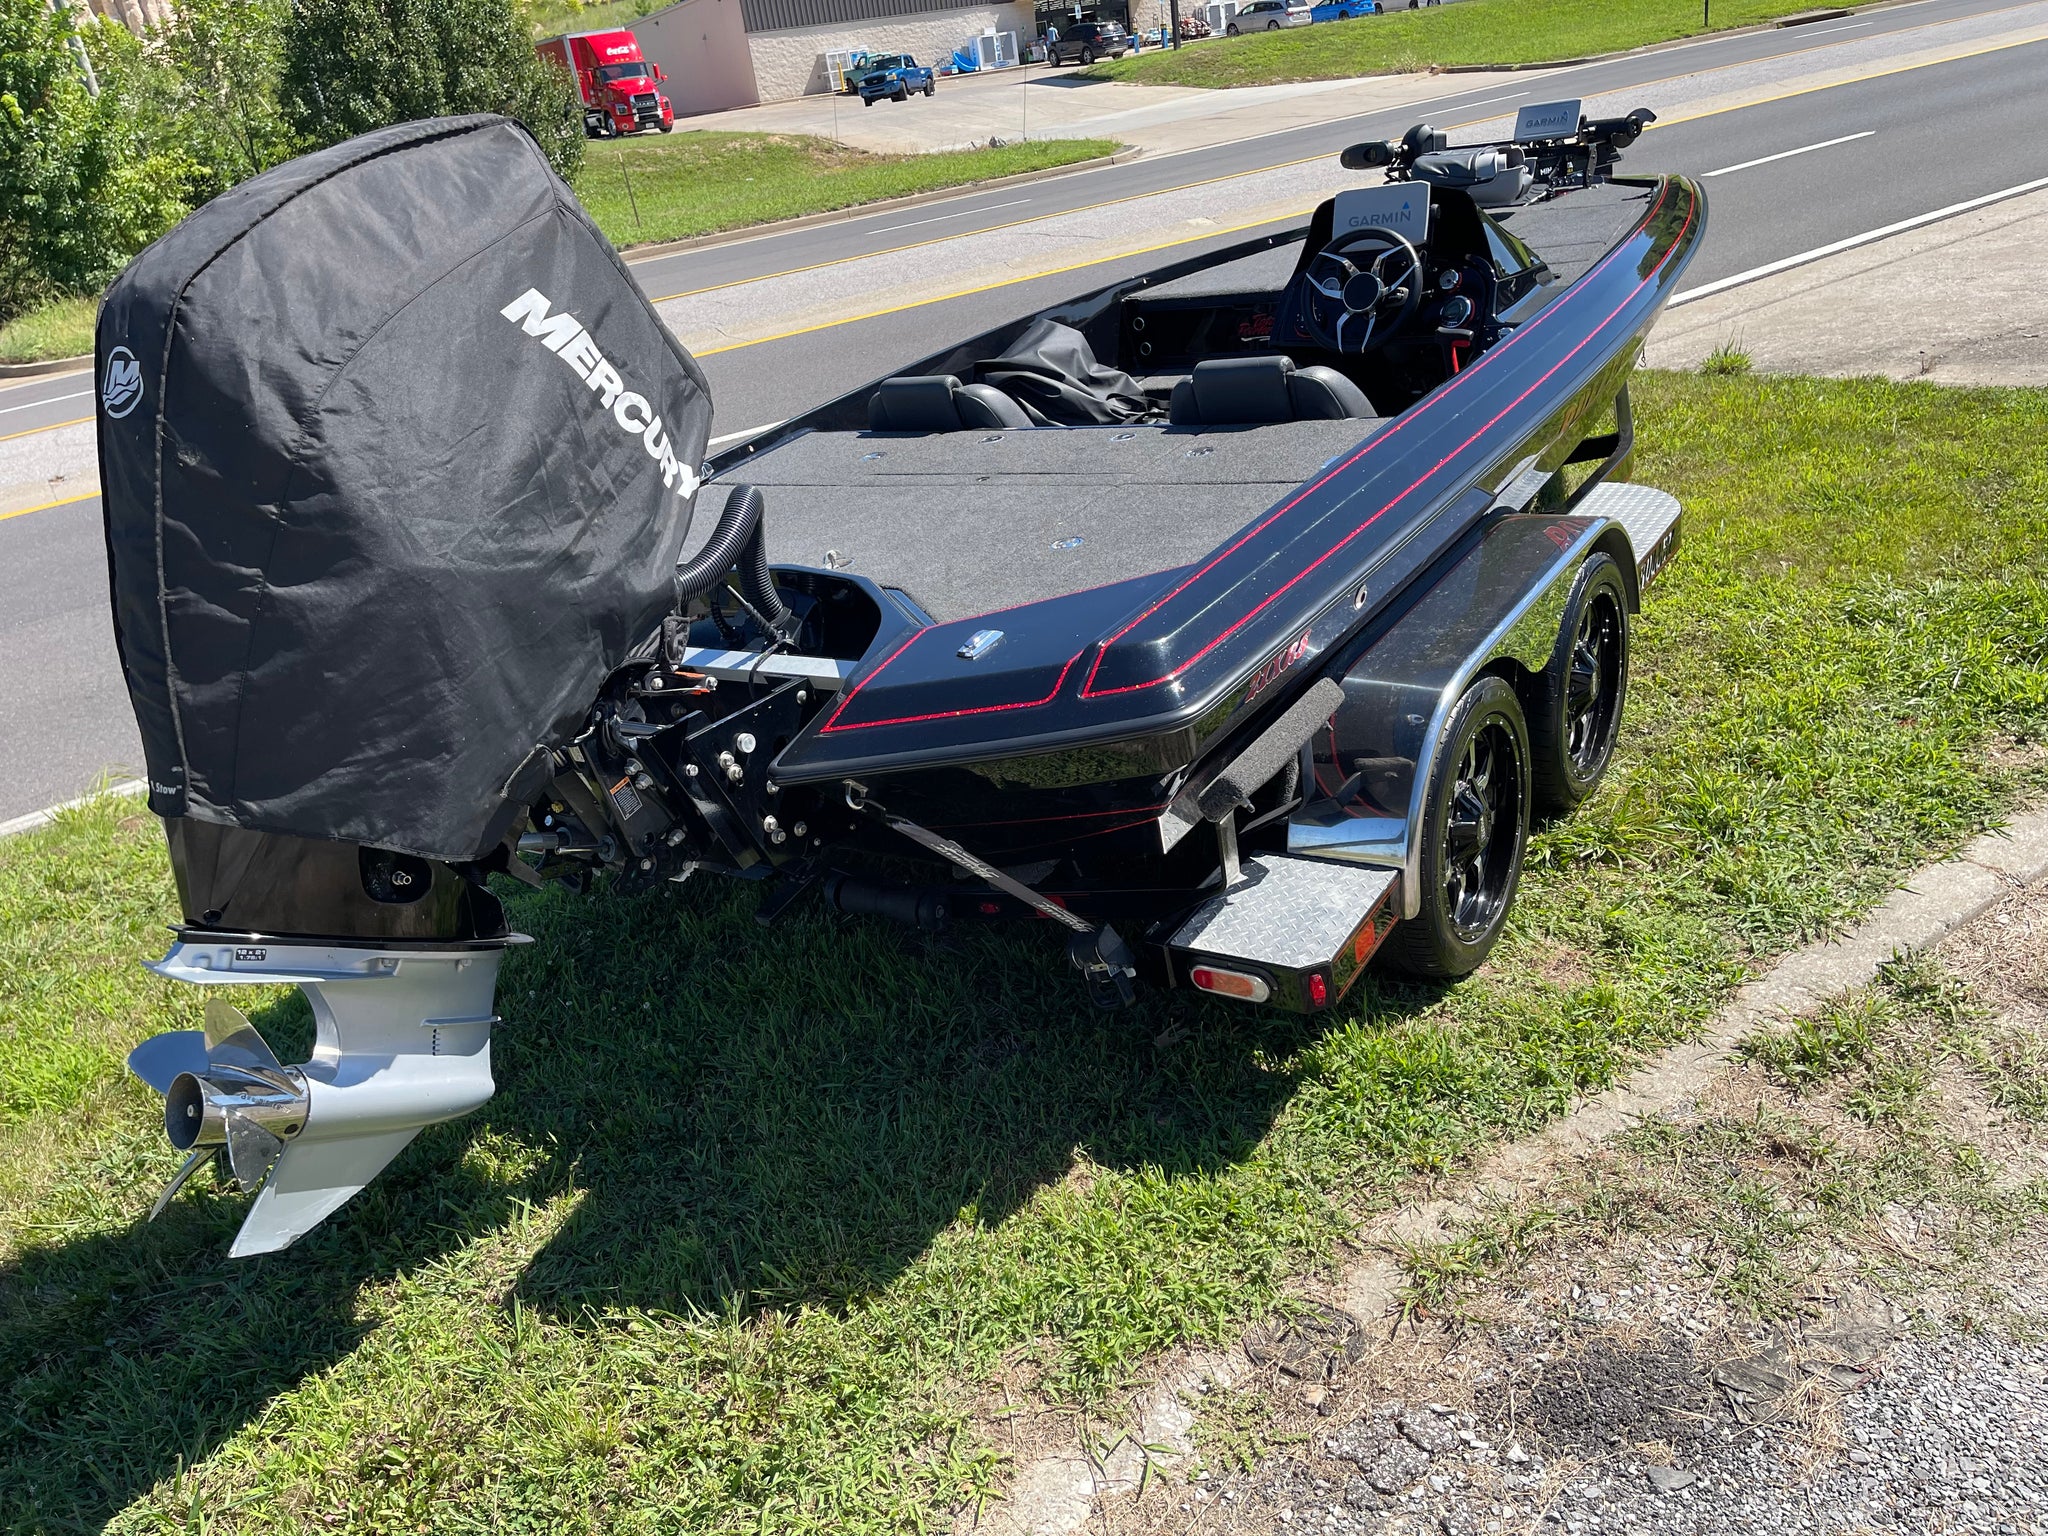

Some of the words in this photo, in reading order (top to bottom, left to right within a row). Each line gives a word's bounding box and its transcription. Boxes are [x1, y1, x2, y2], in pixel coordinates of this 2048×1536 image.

[1526, 115, 1568, 129] GARMIN
[1348, 210, 1411, 228] GARMIN
[500, 287, 700, 499] MERCURY
